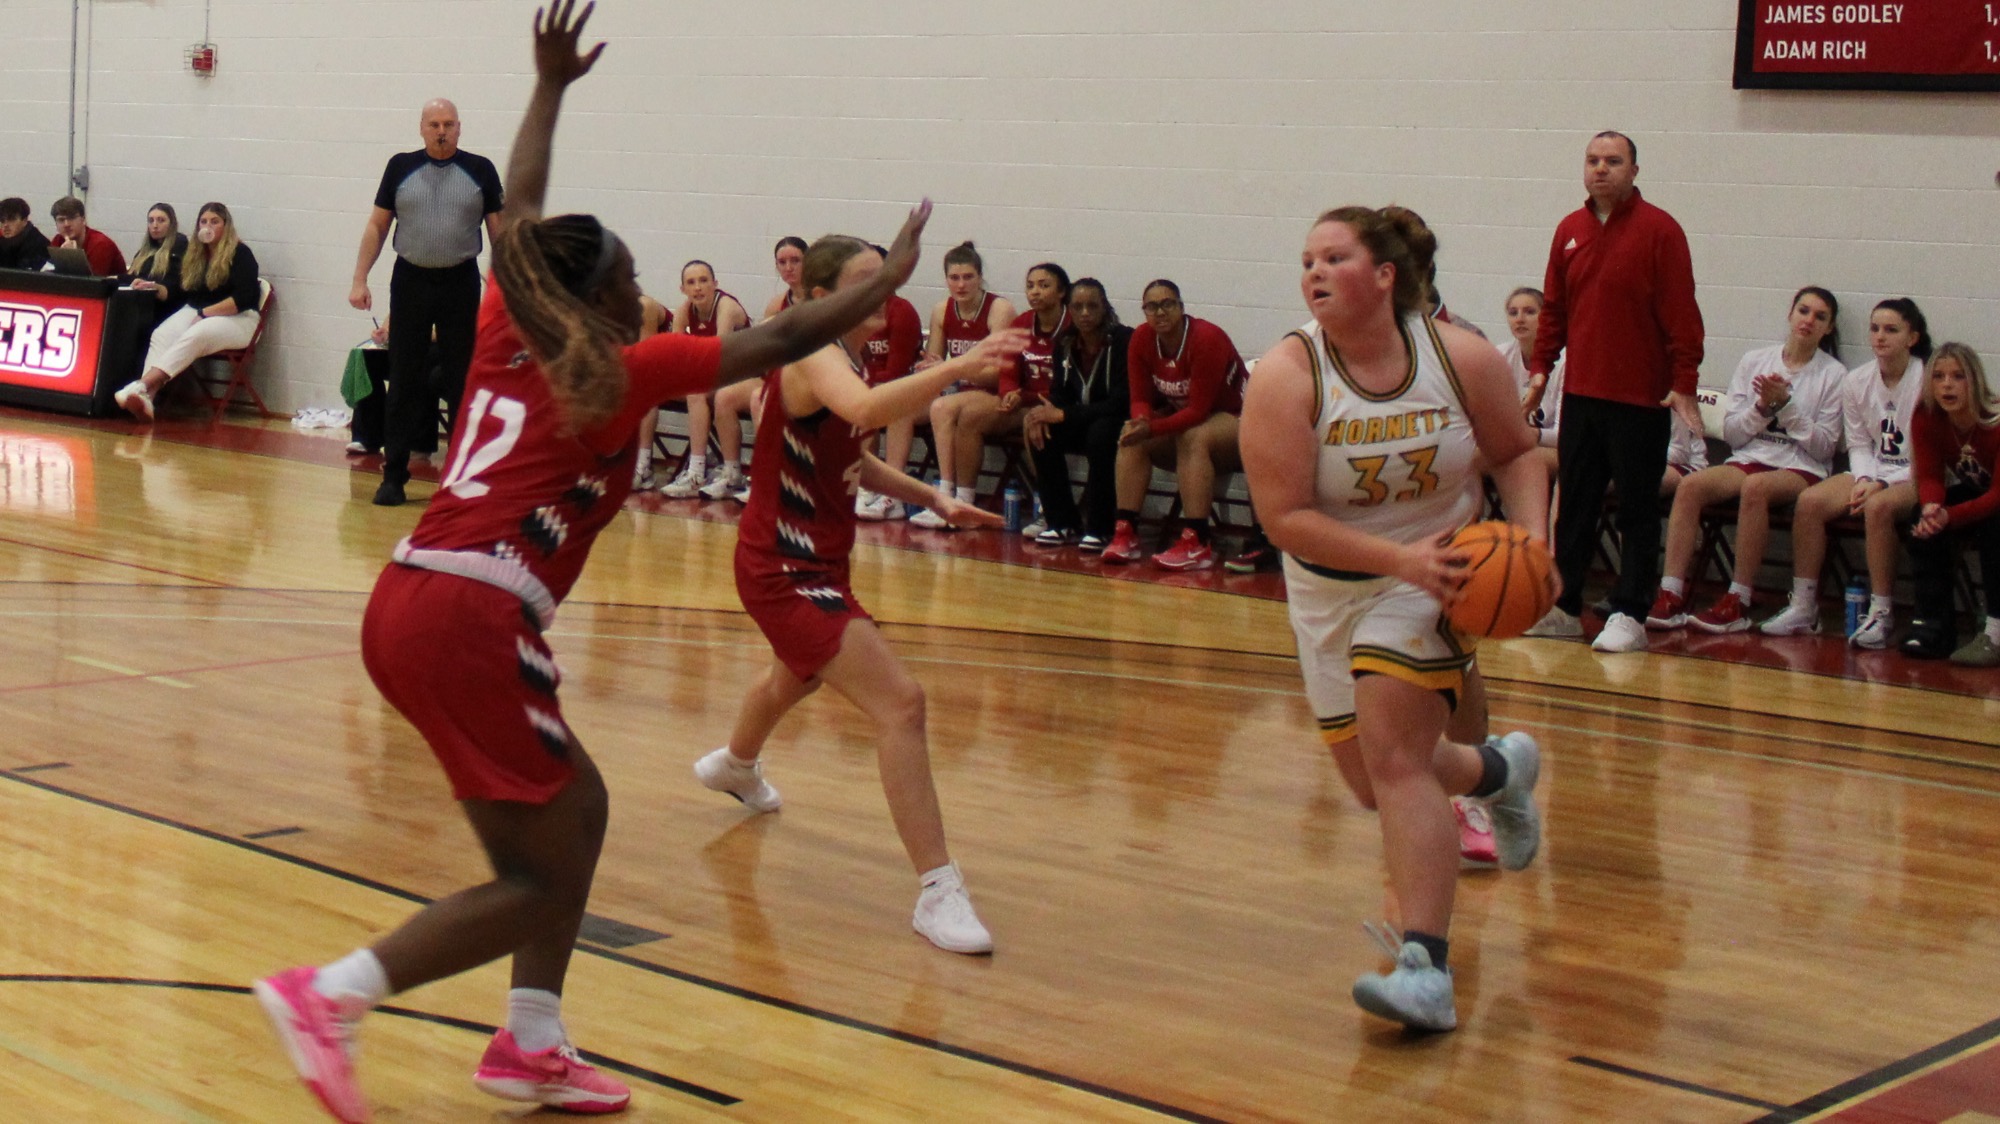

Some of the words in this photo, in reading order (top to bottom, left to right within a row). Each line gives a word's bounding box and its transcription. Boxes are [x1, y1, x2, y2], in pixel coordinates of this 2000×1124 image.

[1764, 5, 1826, 24] JAMES
[1832, 4, 1904, 24] GODLEY
[1984, 4, 2000, 26] 1,
[1763, 40, 1816, 60] ADAM
[1822, 41, 1867, 60] RICH
[1984, 40, 2000, 63] 1,
[441, 388, 527, 500] 12
[1325, 406, 1451, 446] HORNETS
[1347, 445, 1441, 507] 33
